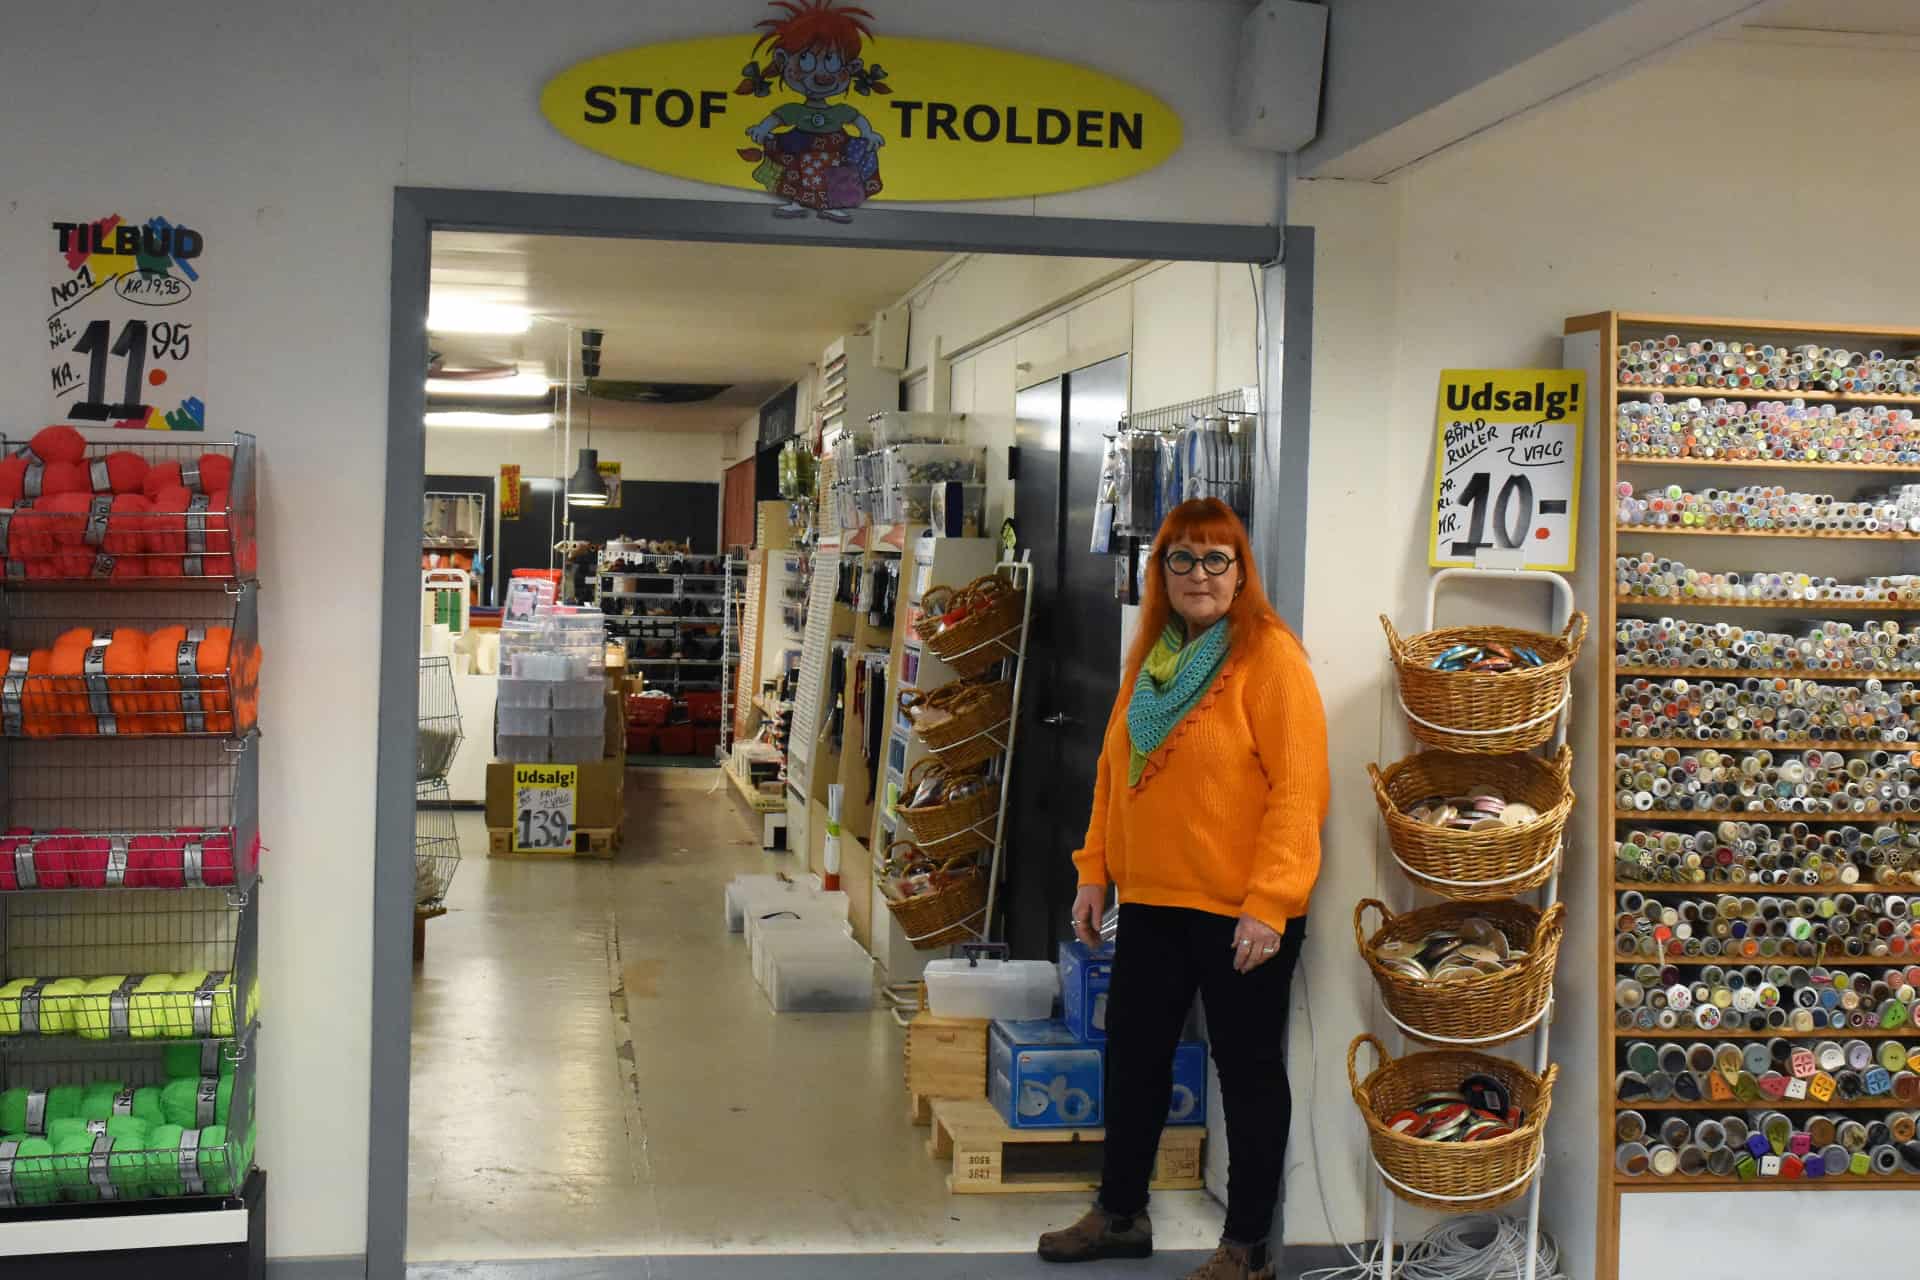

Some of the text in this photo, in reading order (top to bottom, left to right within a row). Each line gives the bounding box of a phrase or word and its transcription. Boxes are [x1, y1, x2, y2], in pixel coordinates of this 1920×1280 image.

[584, 85, 1144, 149] STOF TROLDEN
[52, 221, 204, 259] TILBUD
[1446, 381, 1578, 421] Udsalg!
[1446, 426, 1499, 466] RULLER
[1523, 440, 1564, 462] VALG
[517, 770, 574, 788] Udsalg!
